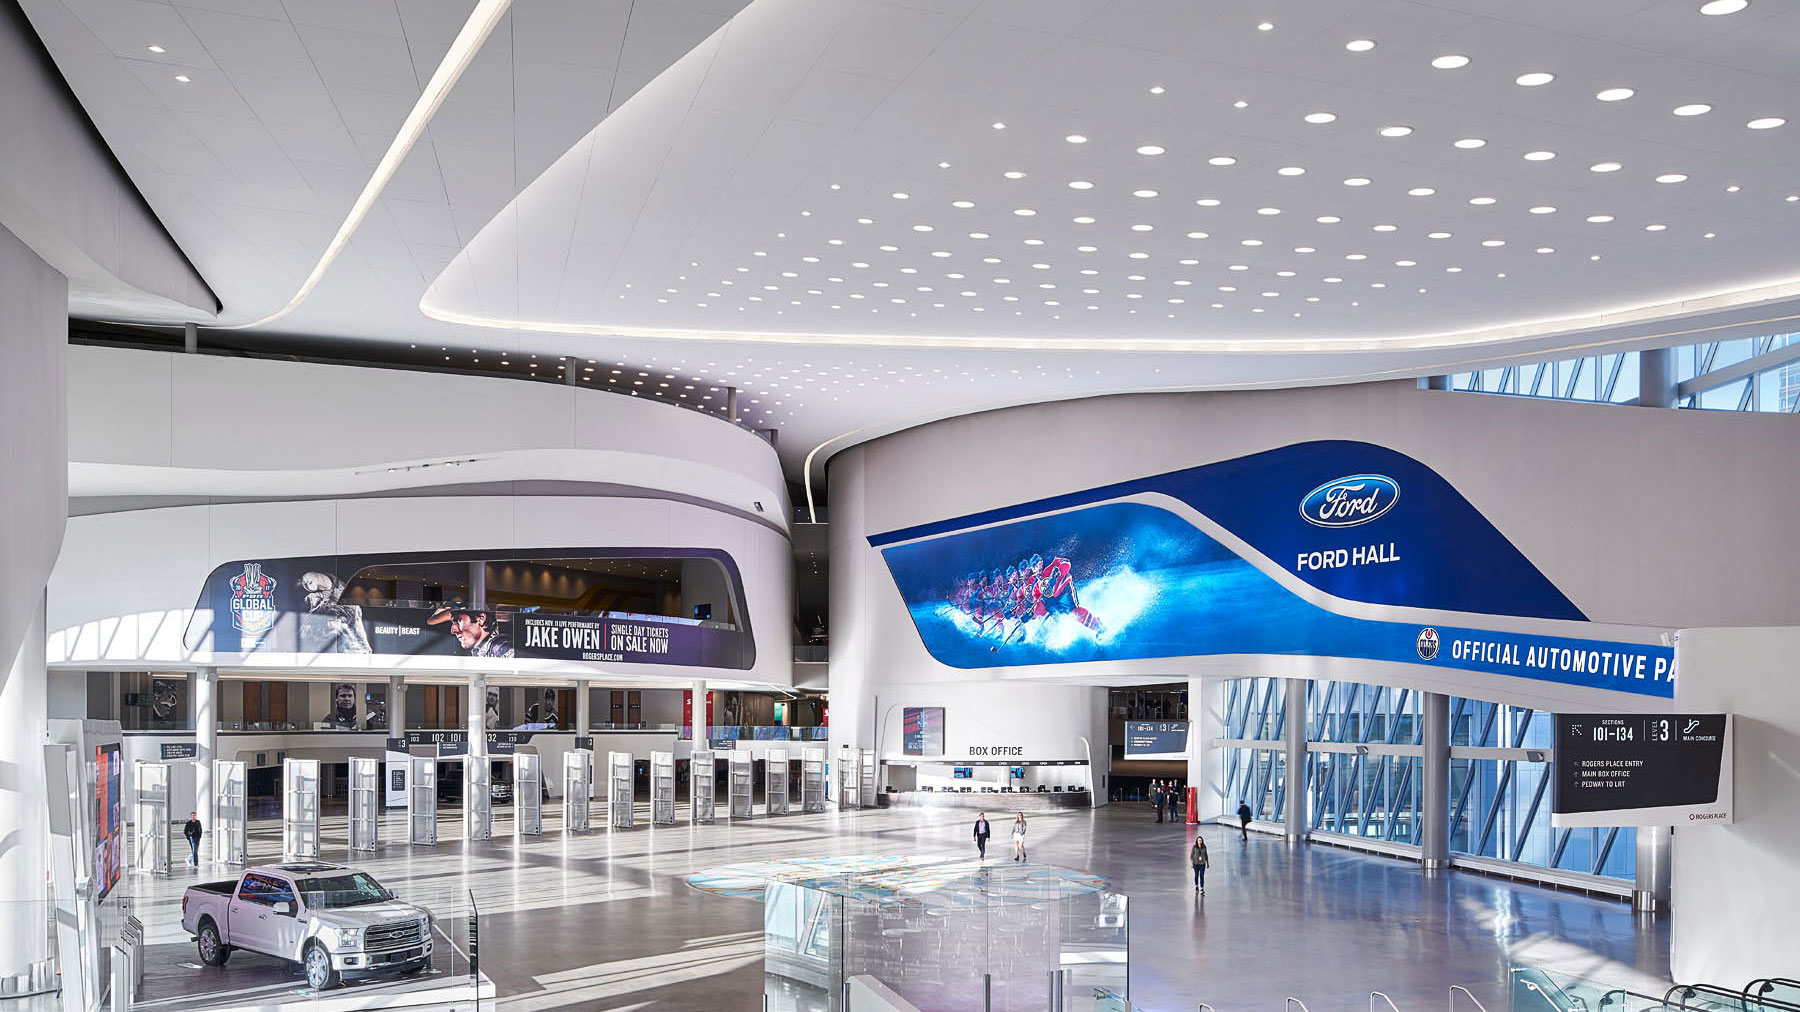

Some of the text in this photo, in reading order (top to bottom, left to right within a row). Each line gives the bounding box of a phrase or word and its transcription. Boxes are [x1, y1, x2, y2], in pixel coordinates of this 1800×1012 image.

[1319, 483, 1379, 520] Ford
[1297, 543, 1400, 571] FORD HALL
[233, 599, 272, 610] GLOBAL
[242, 610, 265, 622] CUP
[401, 627, 420, 635] BEAST
[568, 621, 594, 629] PERFORMANCE
[611, 624, 669, 638] SINGLE DAY TICKETS
[525, 626, 600, 649] JAKE OWEN
[611, 635, 668, 654] ON SALE NOW
[582, 652, 623, 661] ROGERSPLACE.COM
[1452, 640, 1520, 665] OFFICIAL
[1526, 646, 1646, 679] AUTOMOTIVE
[1593, 727, 1633, 741] 101-134
[1660, 720, 1669, 741] 3
[432, 733, 444, 742] 102
[450, 733, 461, 742] 101
[401, 740, 406, 748] 3
[970, 747, 1022, 755] BOX OFFICE
